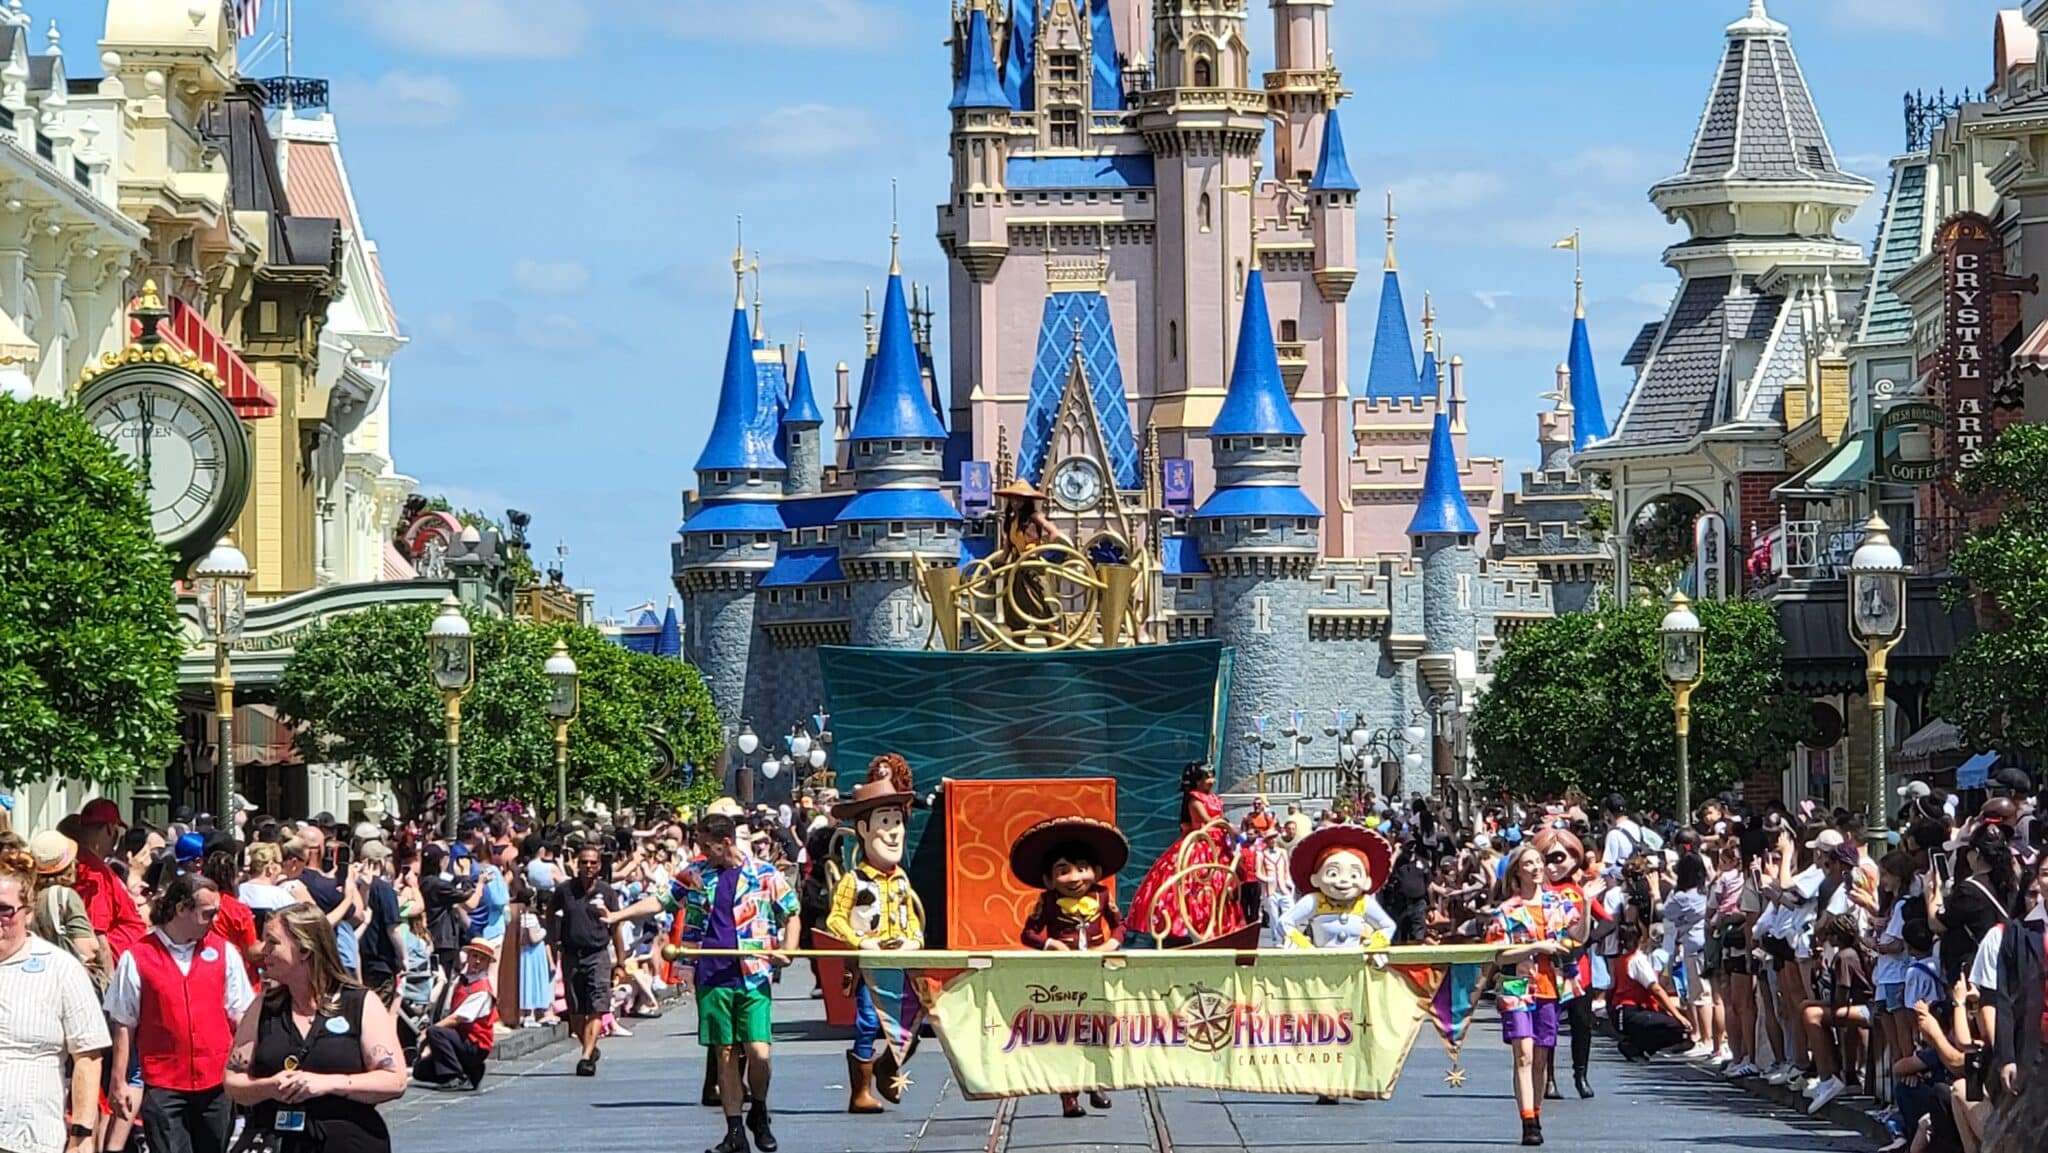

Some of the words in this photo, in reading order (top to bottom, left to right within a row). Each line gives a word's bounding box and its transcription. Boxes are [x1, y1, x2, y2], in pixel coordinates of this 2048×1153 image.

[1954, 253, 1982, 379] CRYSTAL
[121, 426, 172, 439] CITEN
[1957, 398, 1983, 469] ARTS
[1891, 463, 1942, 481] COFFEE
[1238, 1051, 1345, 1067] CAVALCADE
